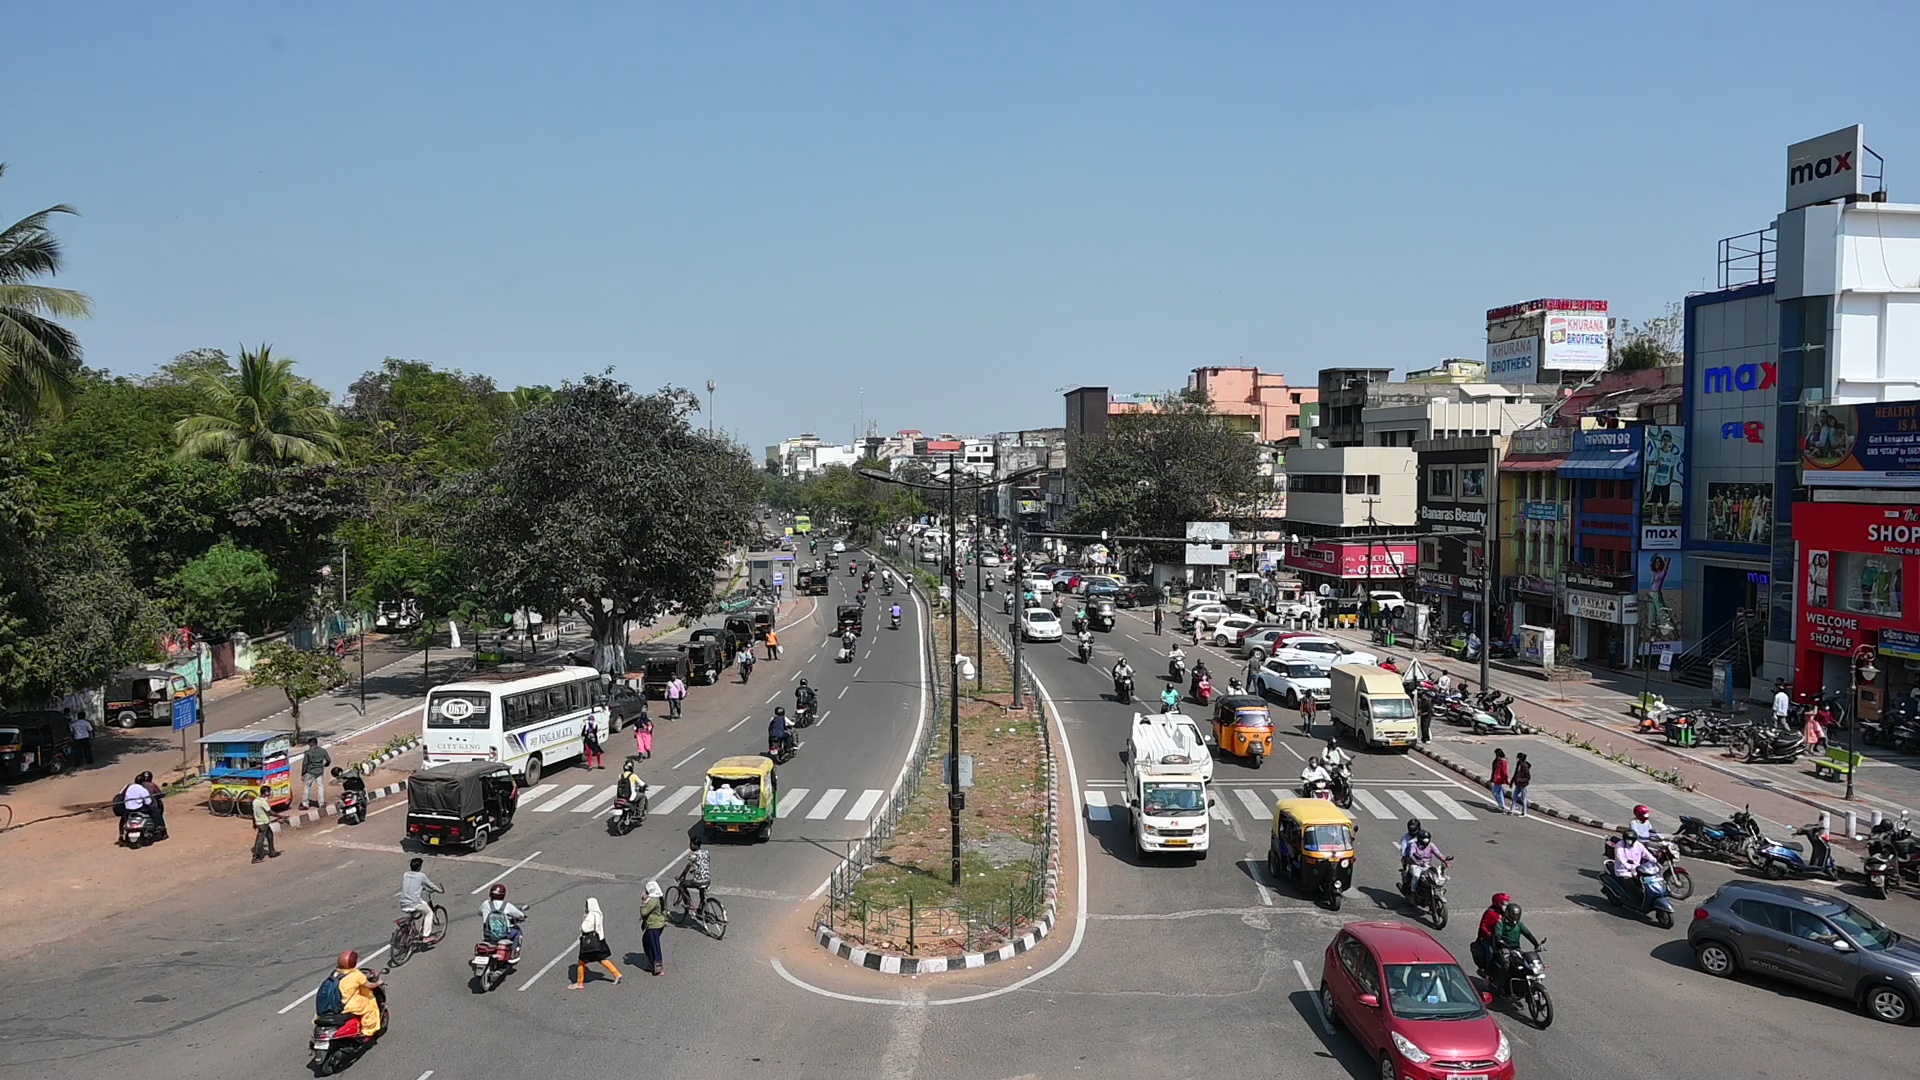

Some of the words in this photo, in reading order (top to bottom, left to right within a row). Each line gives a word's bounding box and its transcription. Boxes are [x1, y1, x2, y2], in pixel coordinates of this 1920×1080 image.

[1790, 150, 1853, 186] max
[1567, 318, 1604, 330] KHURANA
[1567, 333, 1604, 345] BROTHERS
[1492, 339, 1532, 358] KHURANA
[1491, 355, 1532, 373] BROTHERS
[1704, 362, 1777, 394] max
[1875, 405, 1916, 418] HEALTHY
[1898, 420, 1906, 431] IS
[1909, 420, 1917, 430] A
[1421, 506, 1454, 520] Banaras
[1455, 507, 1487, 527] Beauty
[1645, 529, 1678, 539] max
[1806, 611, 1857, 630] WELCOME
[1810, 632, 1852, 647] SHOPPIE
